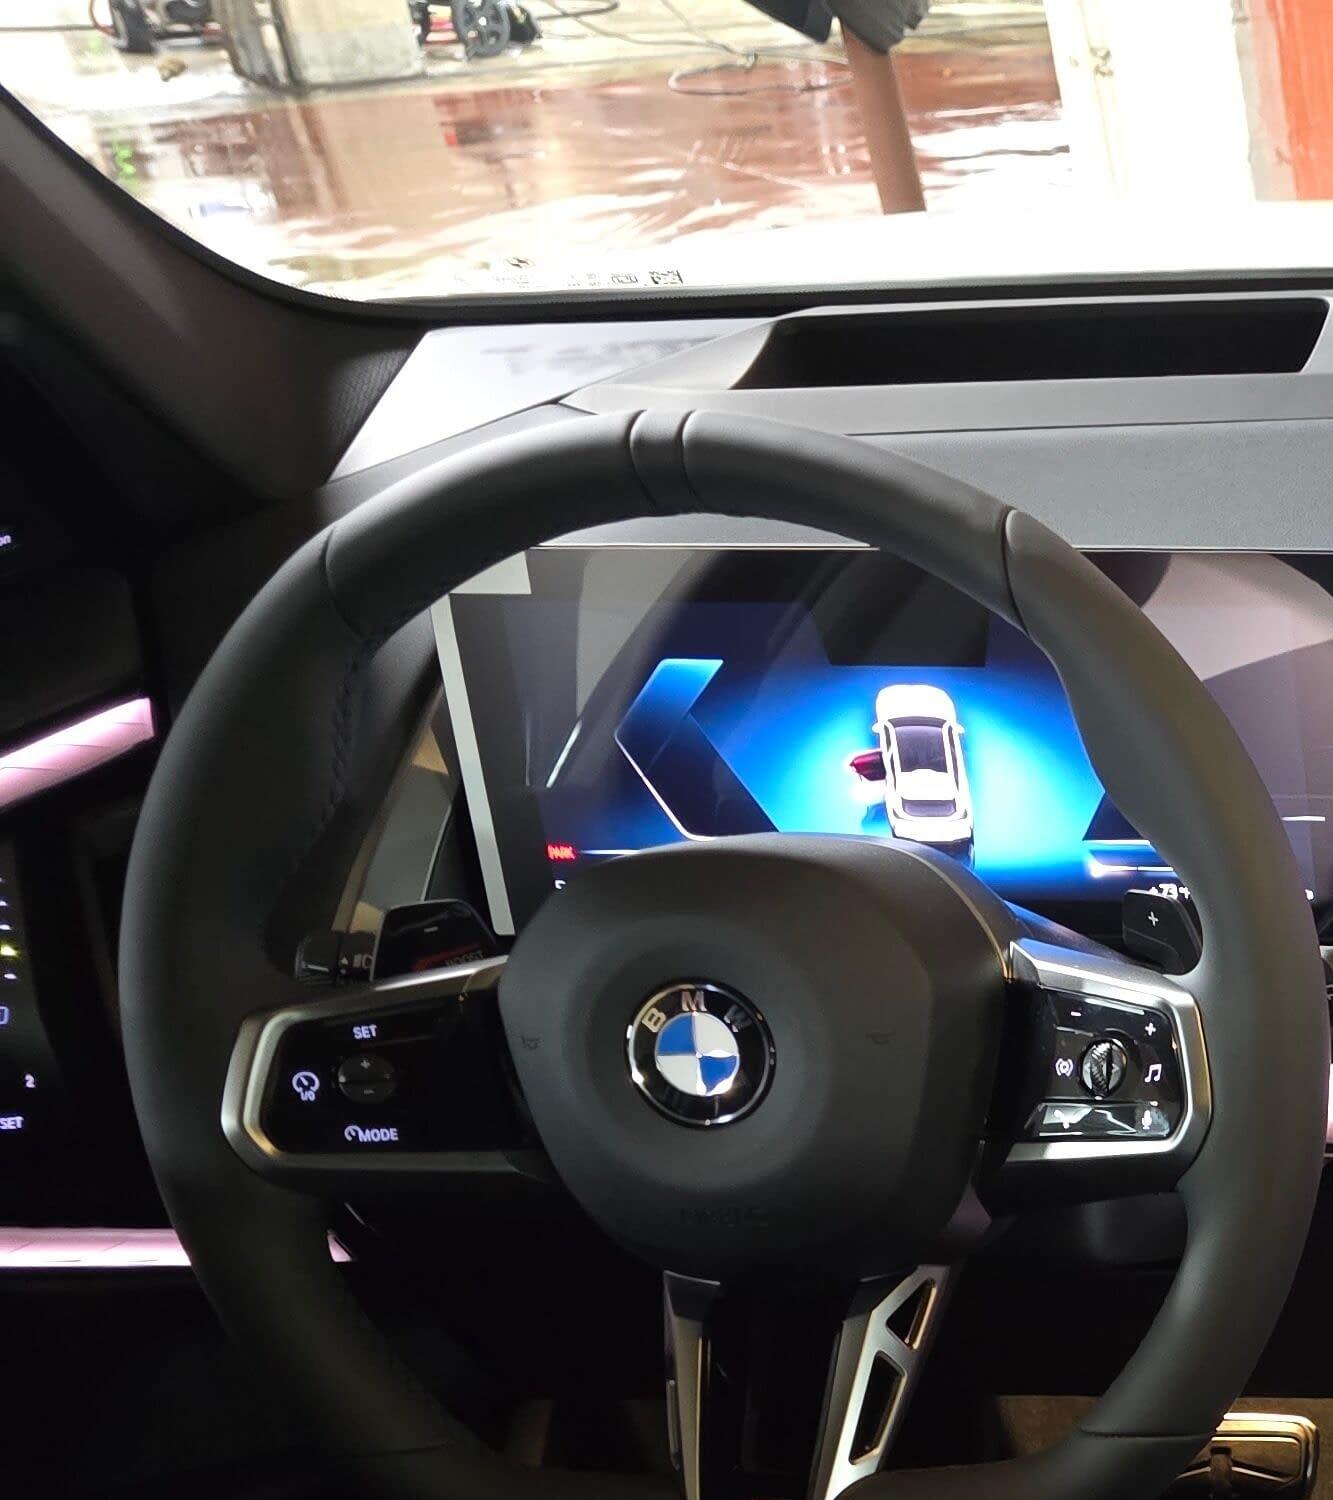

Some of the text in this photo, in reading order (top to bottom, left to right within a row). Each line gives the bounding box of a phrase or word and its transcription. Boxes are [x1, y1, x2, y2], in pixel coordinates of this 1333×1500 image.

[642, 991, 750, 1033] BMW
[352, 1024, 378, 1039] SET
[25, 1074, 36, 1088] 2
[0, 1115, 24, 1130] SET
[358, 1127, 399, 1142] MODE
